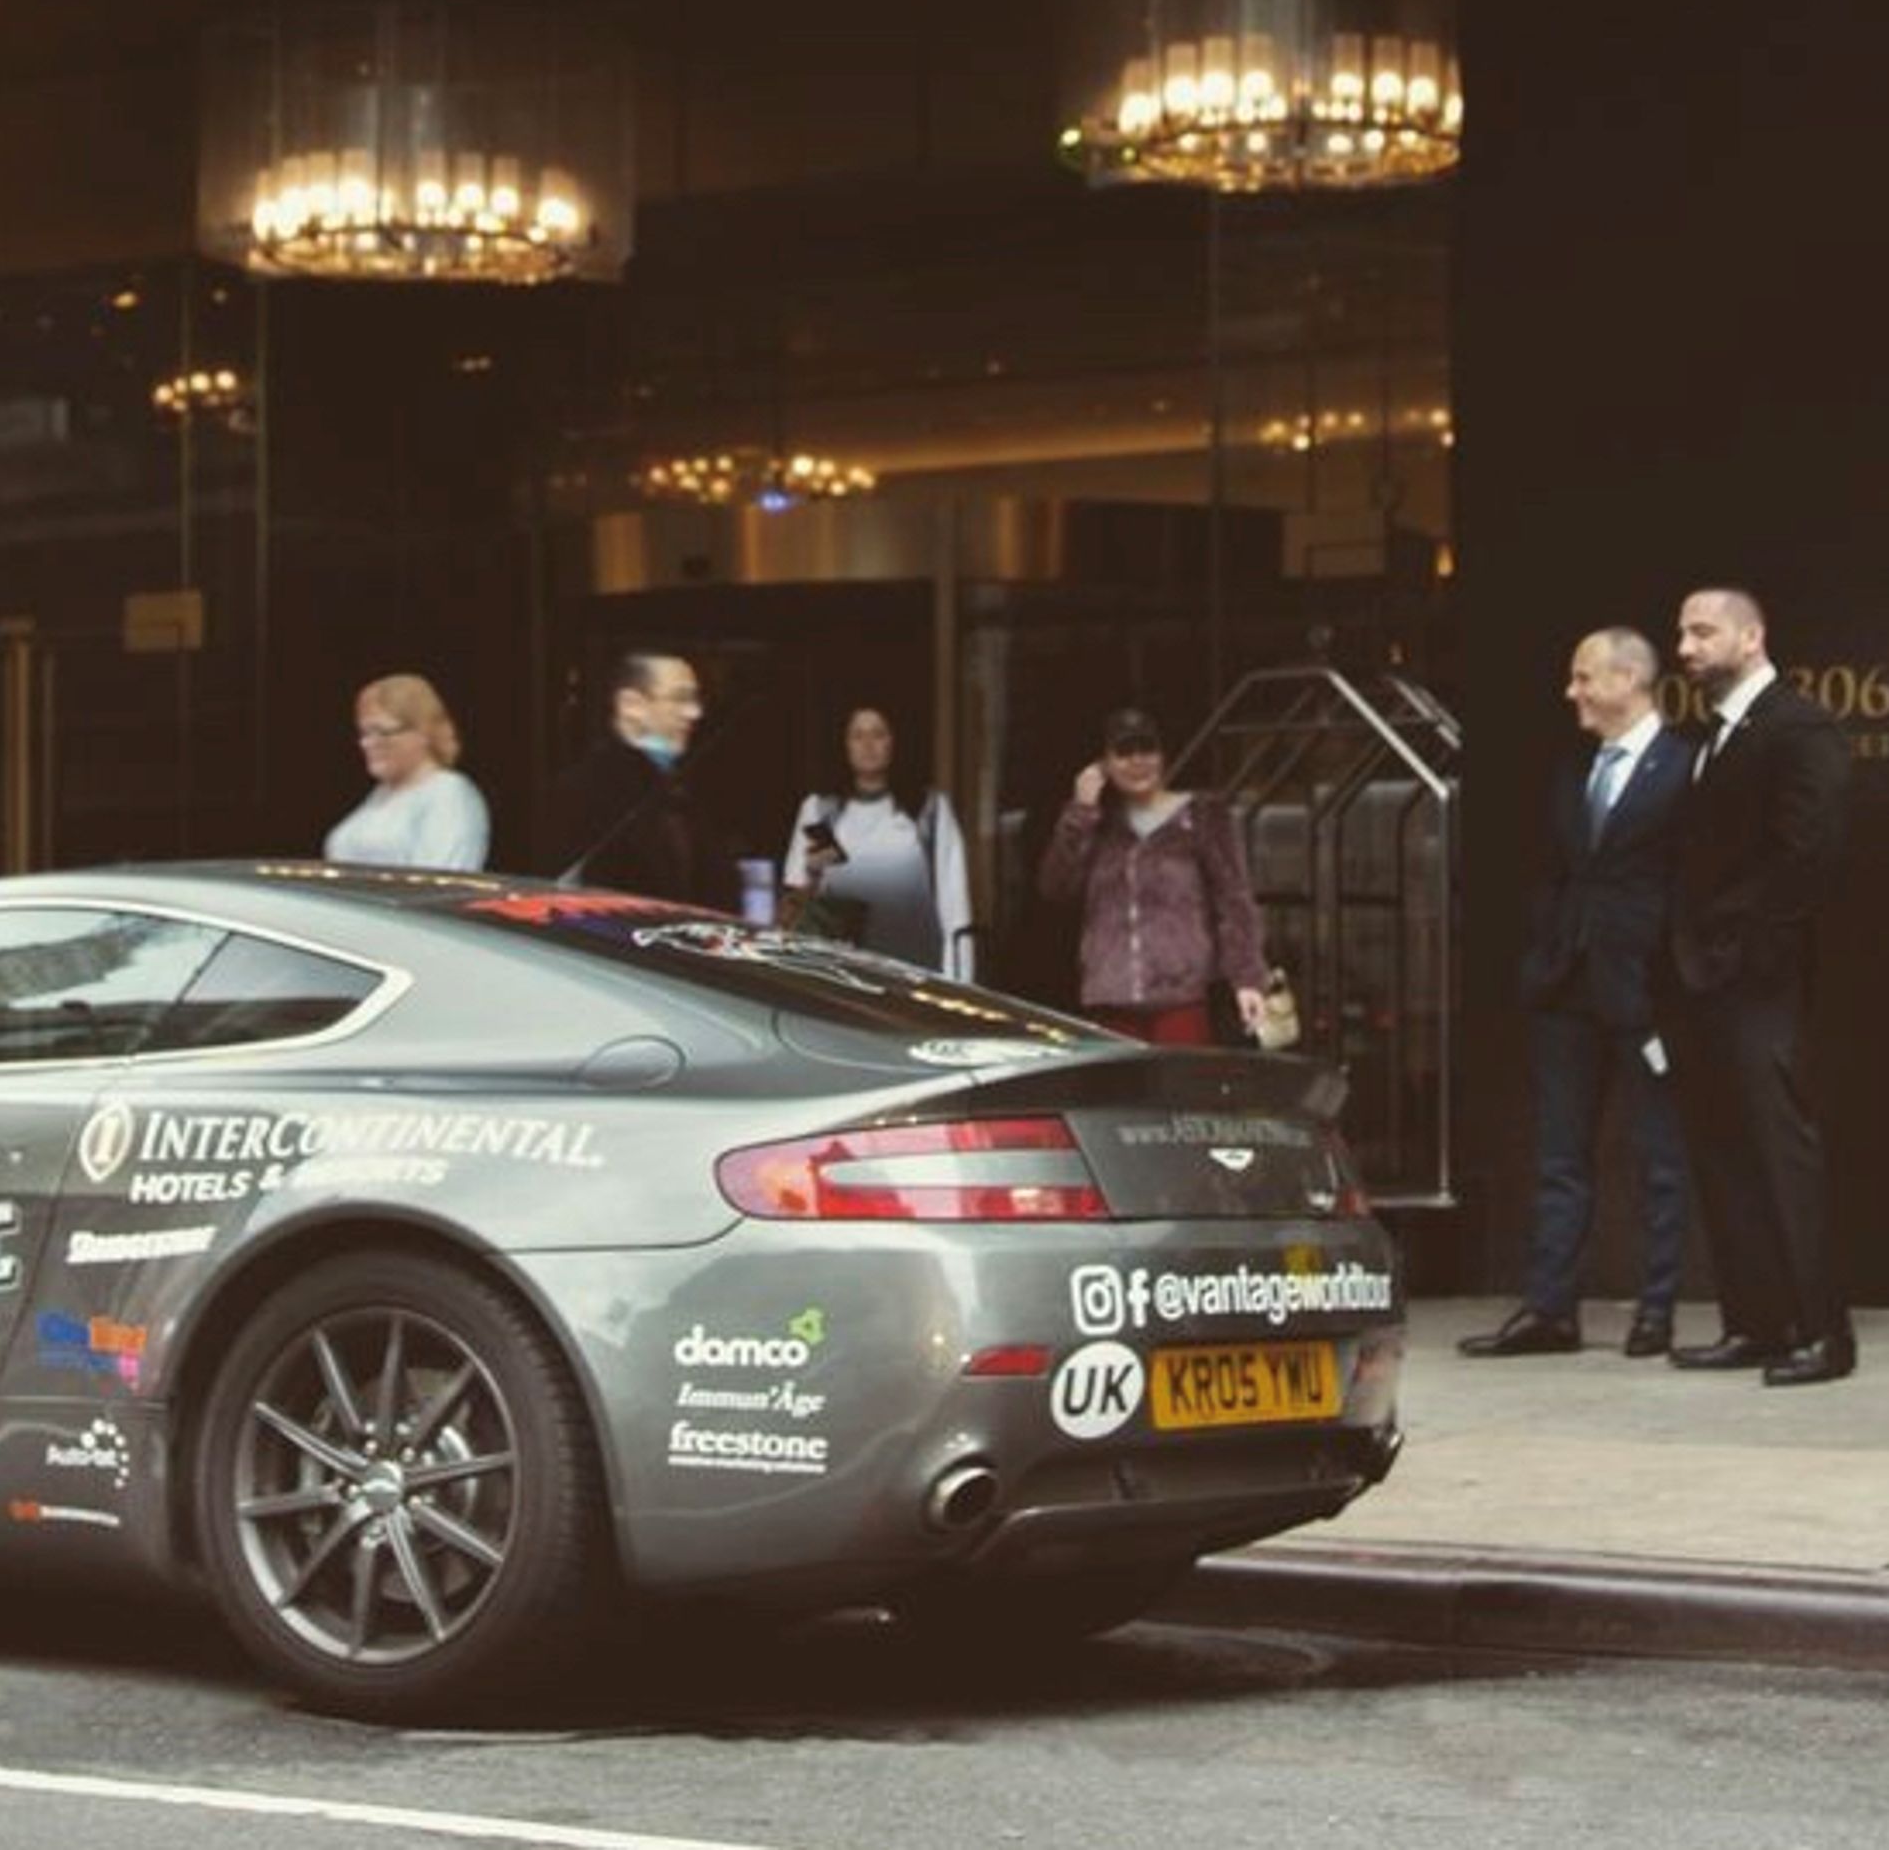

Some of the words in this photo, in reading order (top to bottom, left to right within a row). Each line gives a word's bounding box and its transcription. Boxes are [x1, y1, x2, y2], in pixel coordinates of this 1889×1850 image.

[129, 1168, 253, 1204] HOTELS
[674, 1323, 809, 1367] damco
[1061, 1362, 1133, 1417] UK
[1167, 1352, 1259, 1417] KR05
[668, 1419, 829, 1460] freestone
